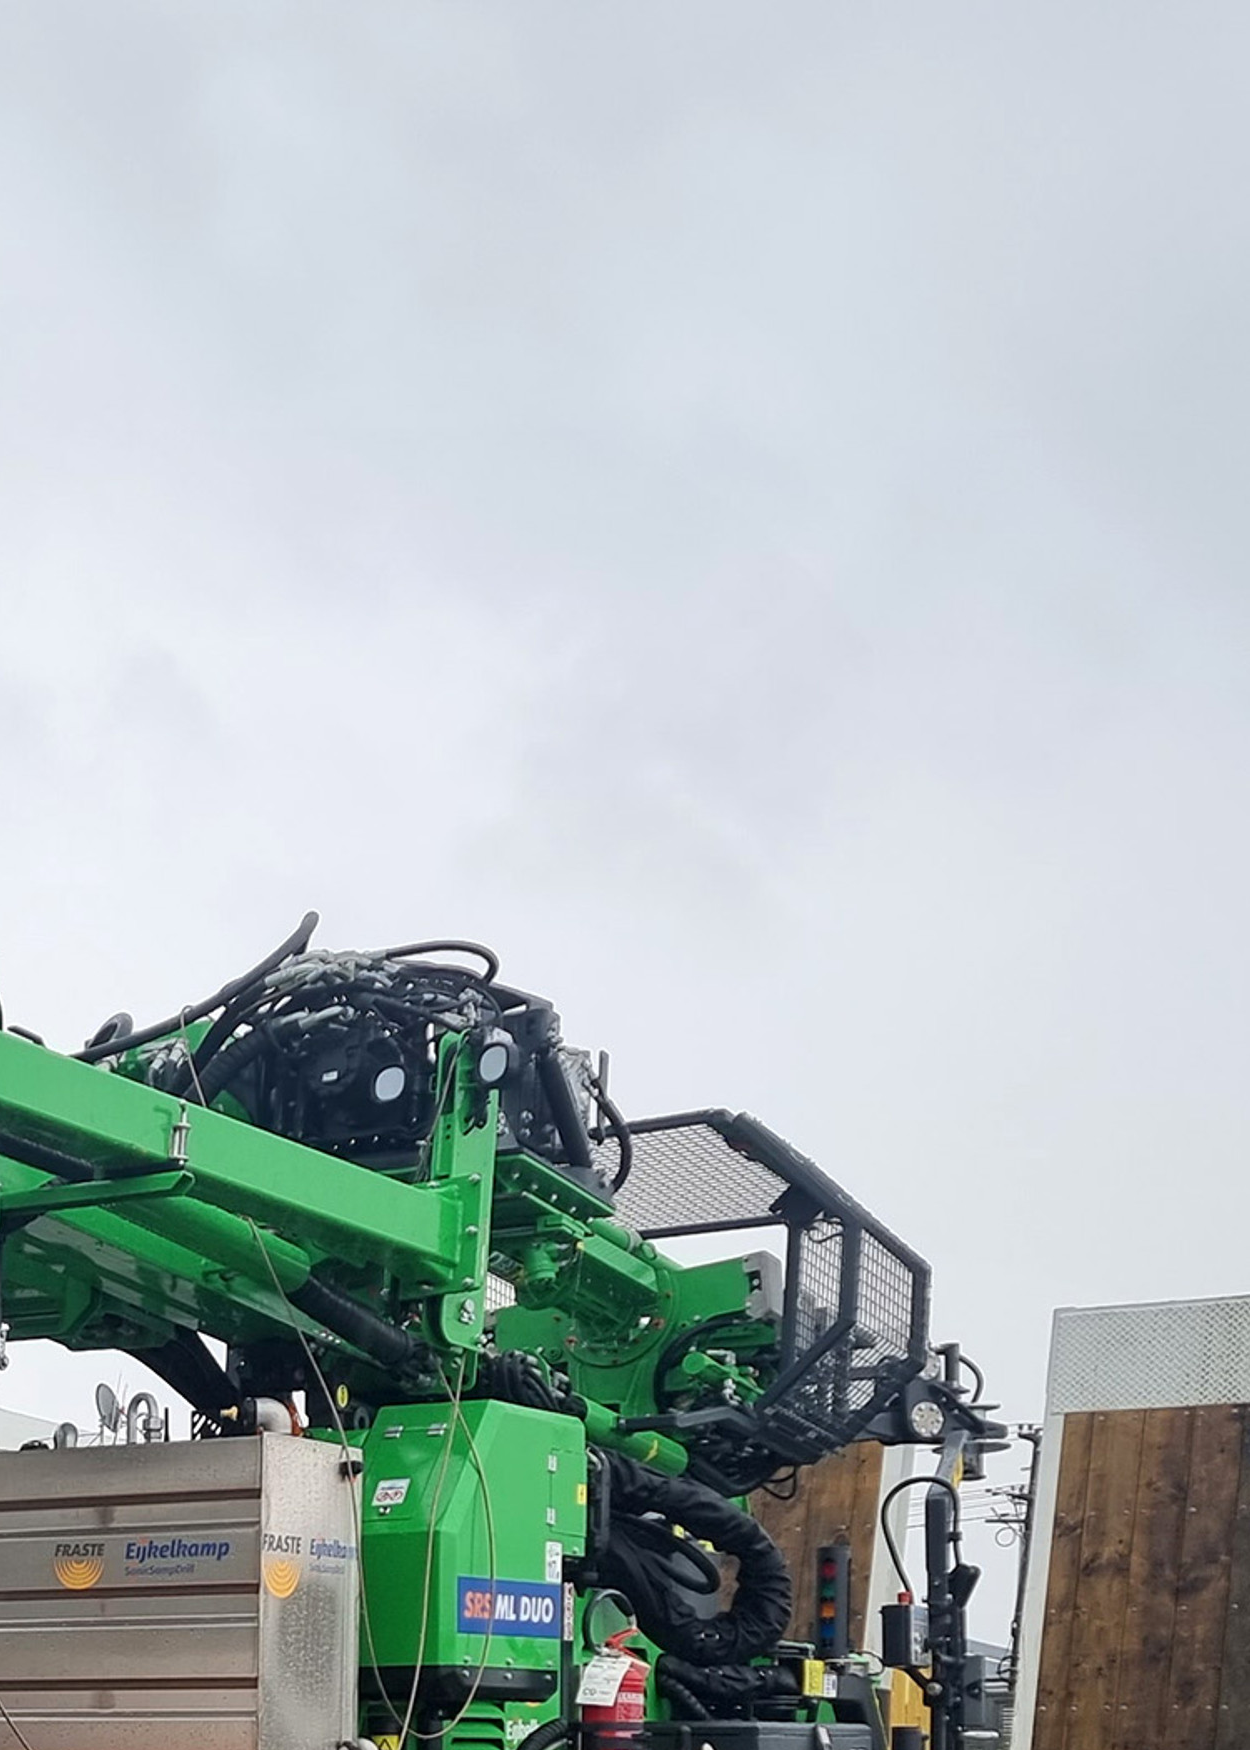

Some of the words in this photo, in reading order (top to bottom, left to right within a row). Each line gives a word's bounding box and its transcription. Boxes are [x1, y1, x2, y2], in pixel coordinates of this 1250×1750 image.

[54, 1543, 105, 1557] FRASTE
[125, 1538, 230, 1564] Eijkelkamp
[262, 1533, 302, 1555] FRASTE
[463, 1590, 492, 1620] SRS
[494, 1593, 517, 1621] ML
[519, 1596, 554, 1623] DUO
